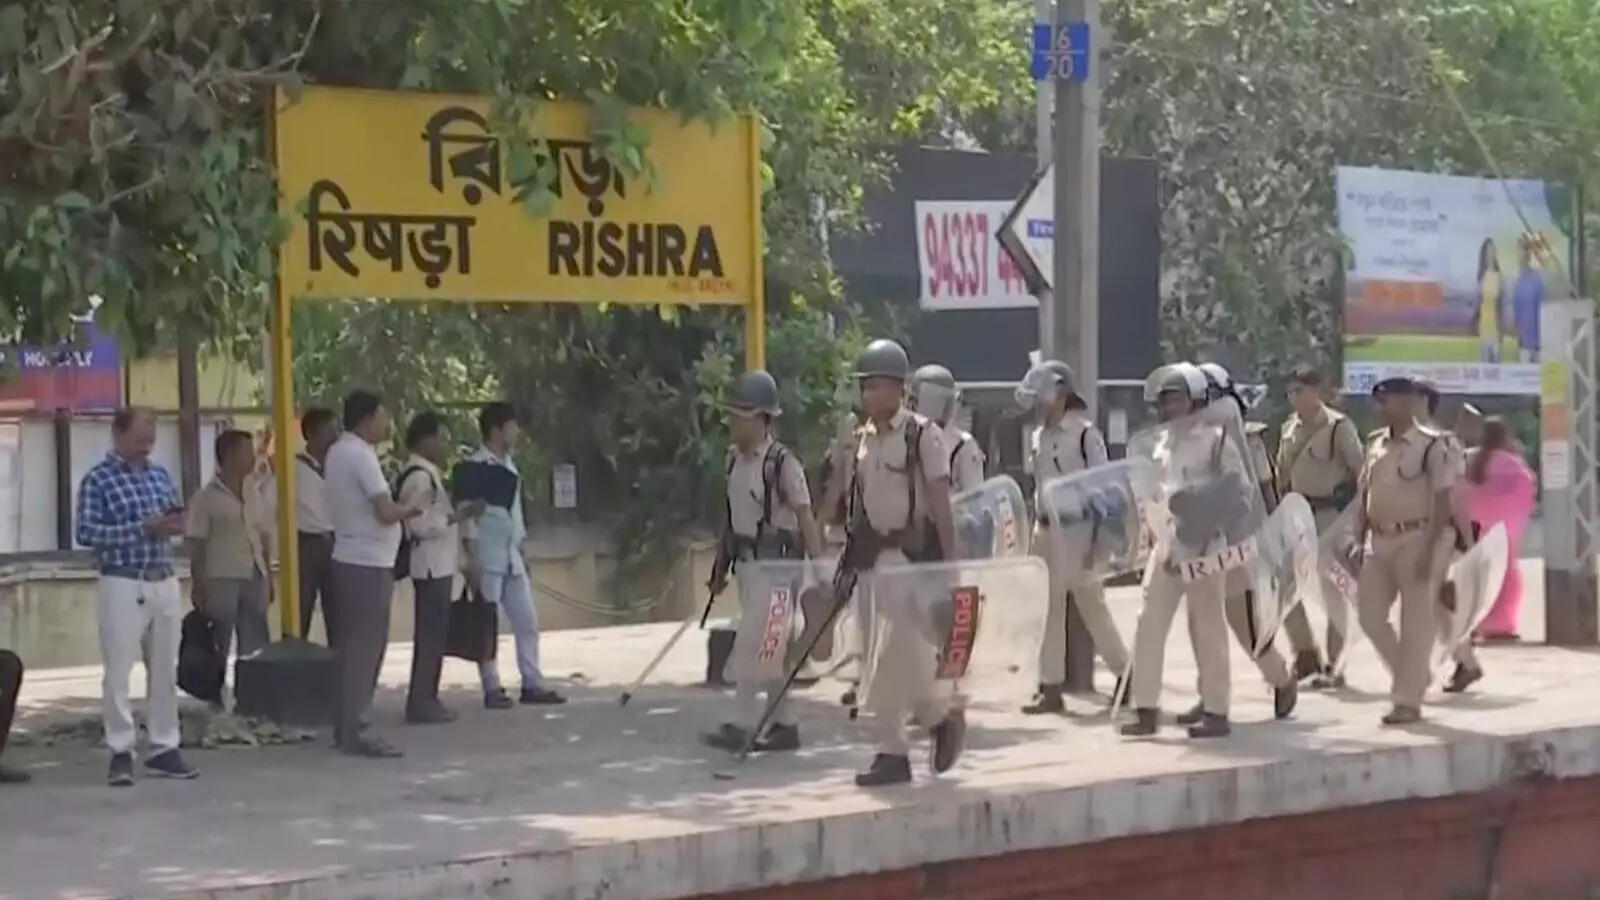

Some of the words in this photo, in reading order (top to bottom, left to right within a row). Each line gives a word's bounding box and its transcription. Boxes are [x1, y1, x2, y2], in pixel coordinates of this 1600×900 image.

[1044, 55, 1073, 79] 20
[304, 180, 476, 289] रिषड़ा
[548, 220, 724, 278] RISHRA
[924, 212, 989, 298] 94337
[758, 590, 788, 664] POLICE
